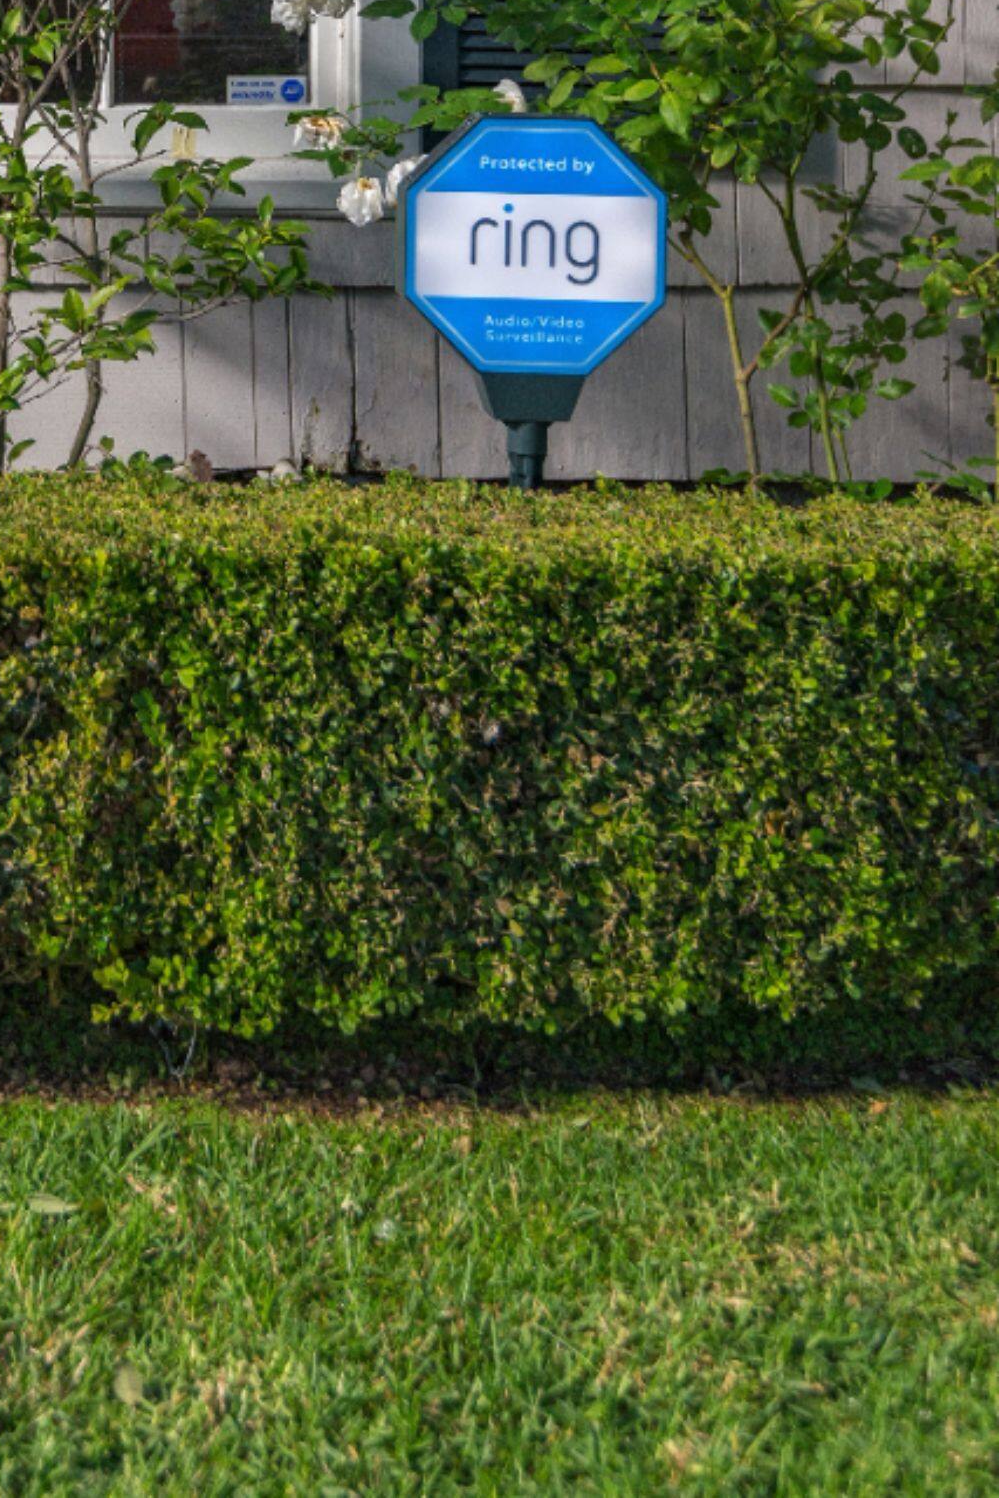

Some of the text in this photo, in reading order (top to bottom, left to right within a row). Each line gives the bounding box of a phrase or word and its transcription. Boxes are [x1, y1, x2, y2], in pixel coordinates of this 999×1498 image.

[479, 155, 595, 175] Protected by
[470, 203, 599, 285] ring
